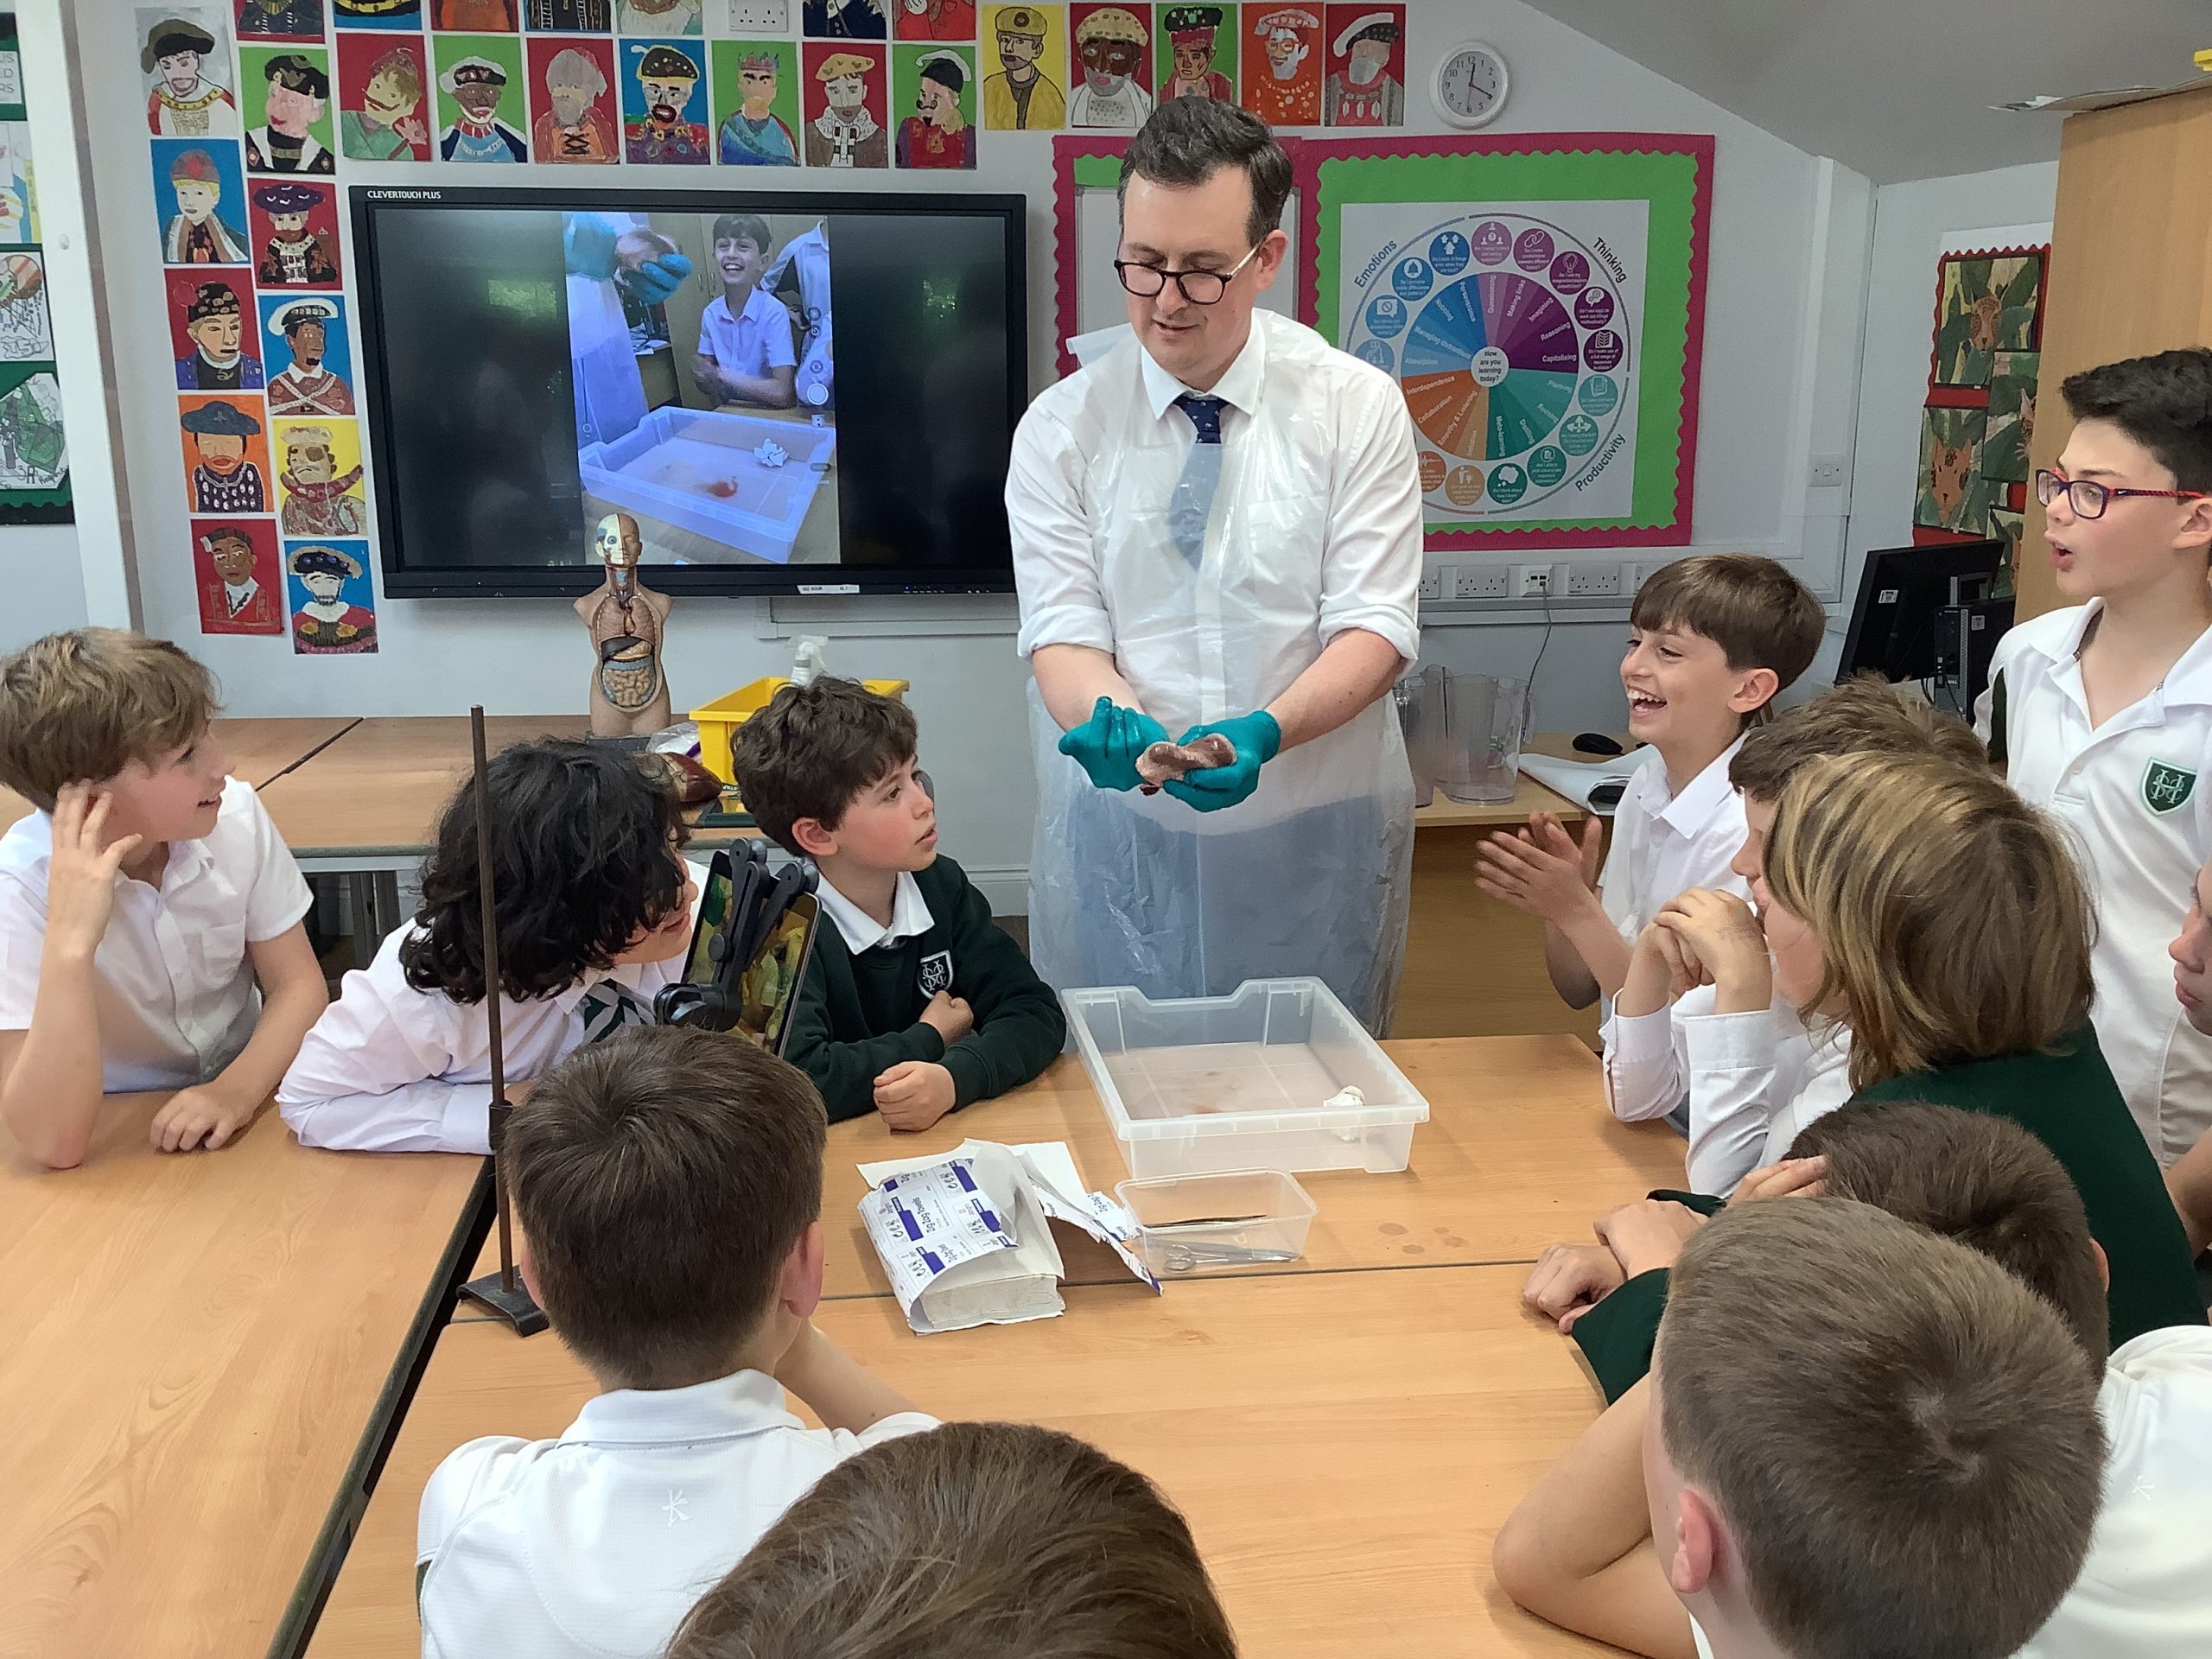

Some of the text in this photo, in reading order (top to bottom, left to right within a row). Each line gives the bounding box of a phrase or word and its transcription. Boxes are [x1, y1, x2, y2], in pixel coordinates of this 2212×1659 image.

[367, 190, 422, 199] CLEVERTOUCH
[1354, 240, 1397, 288] Emotions
[1593, 237, 1627, 283] Thinking
[1488, 276, 1497, 314] Questioning
[1507, 280, 1526, 317] Making links
[1529, 297, 1554, 322] Imagining
[1540, 321, 1571, 341] Reasoning
[1541, 353, 1576, 363] Capitalising
[1407, 375, 1455, 395] Interdependence
[1417, 395, 1453, 424] Collaboration
[1438, 420, 1457, 446] Empathy
[1459, 391, 1478, 416] Listening
[1574, 434, 1626, 492] Productivity
[911, 1196, 938, 1234] Zig Zag Towels
